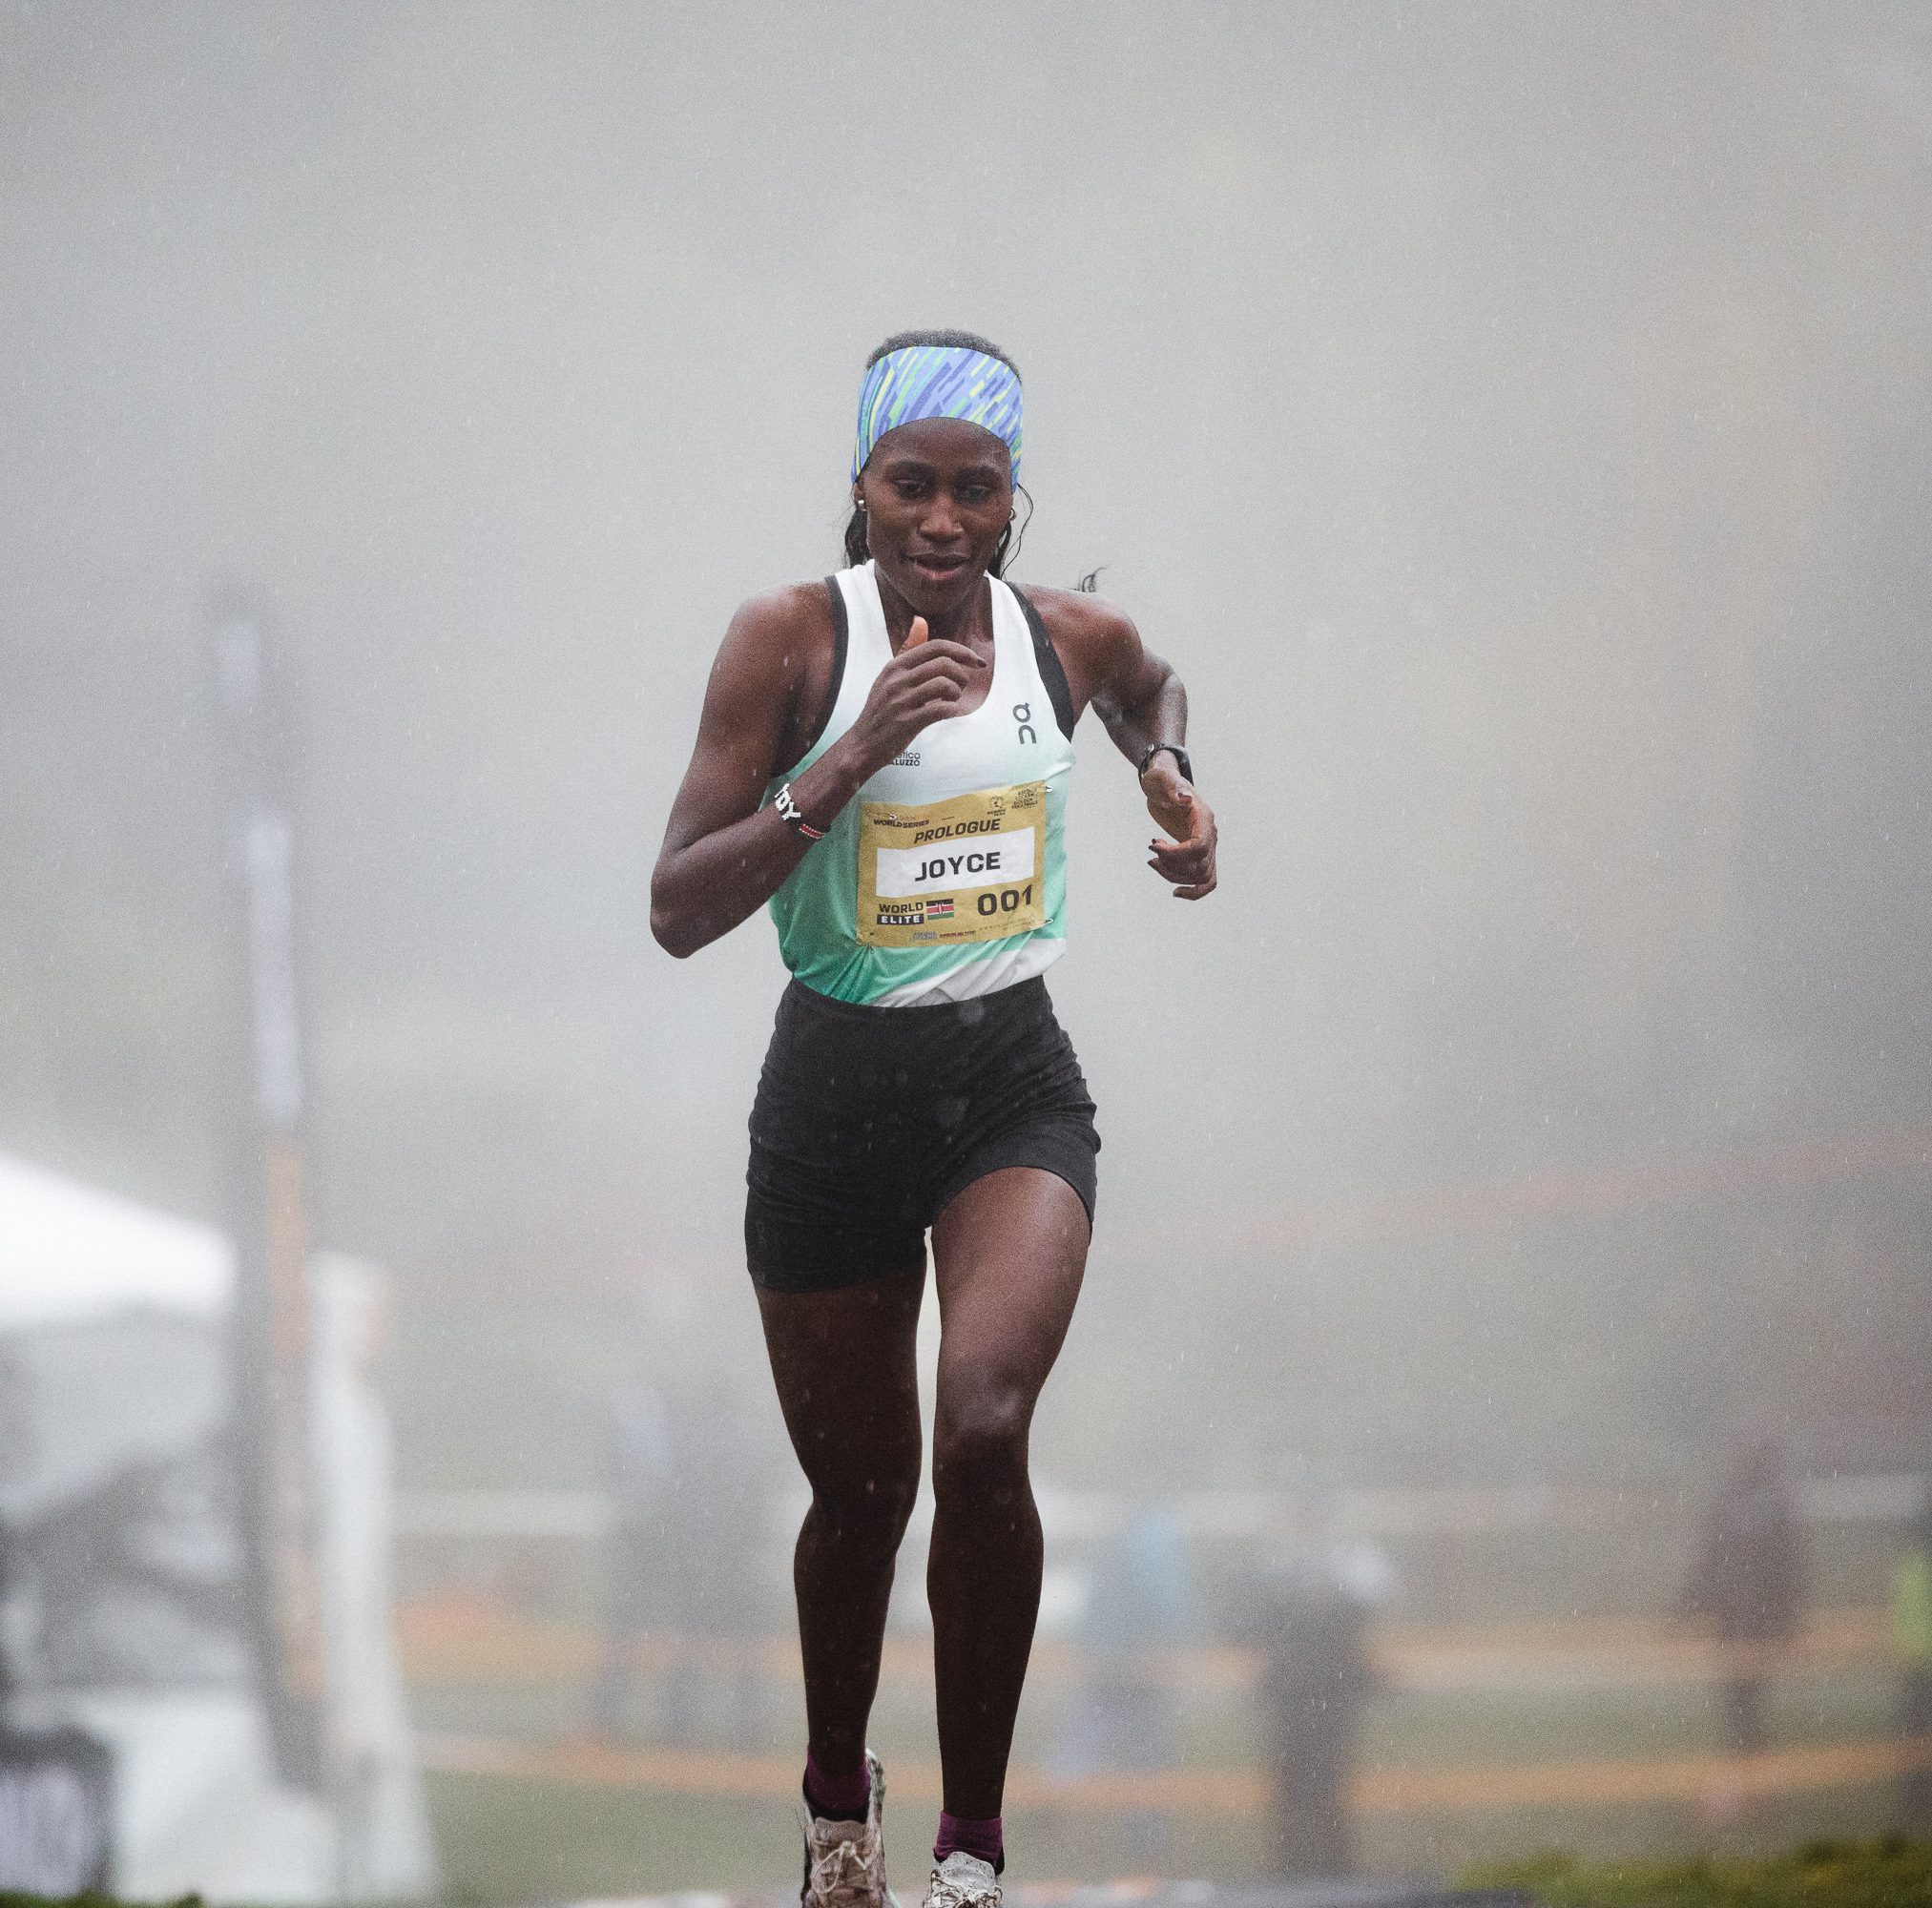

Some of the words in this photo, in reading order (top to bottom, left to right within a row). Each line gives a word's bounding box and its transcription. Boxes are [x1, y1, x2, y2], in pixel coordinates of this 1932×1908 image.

[913, 819, 1001, 843] PROLOGUE
[914, 851, 1001, 881] JOYCE
[879, 902, 924, 914] WORLD
[977, 884, 1032, 916] 001
[881, 915, 921, 924] ELITE
